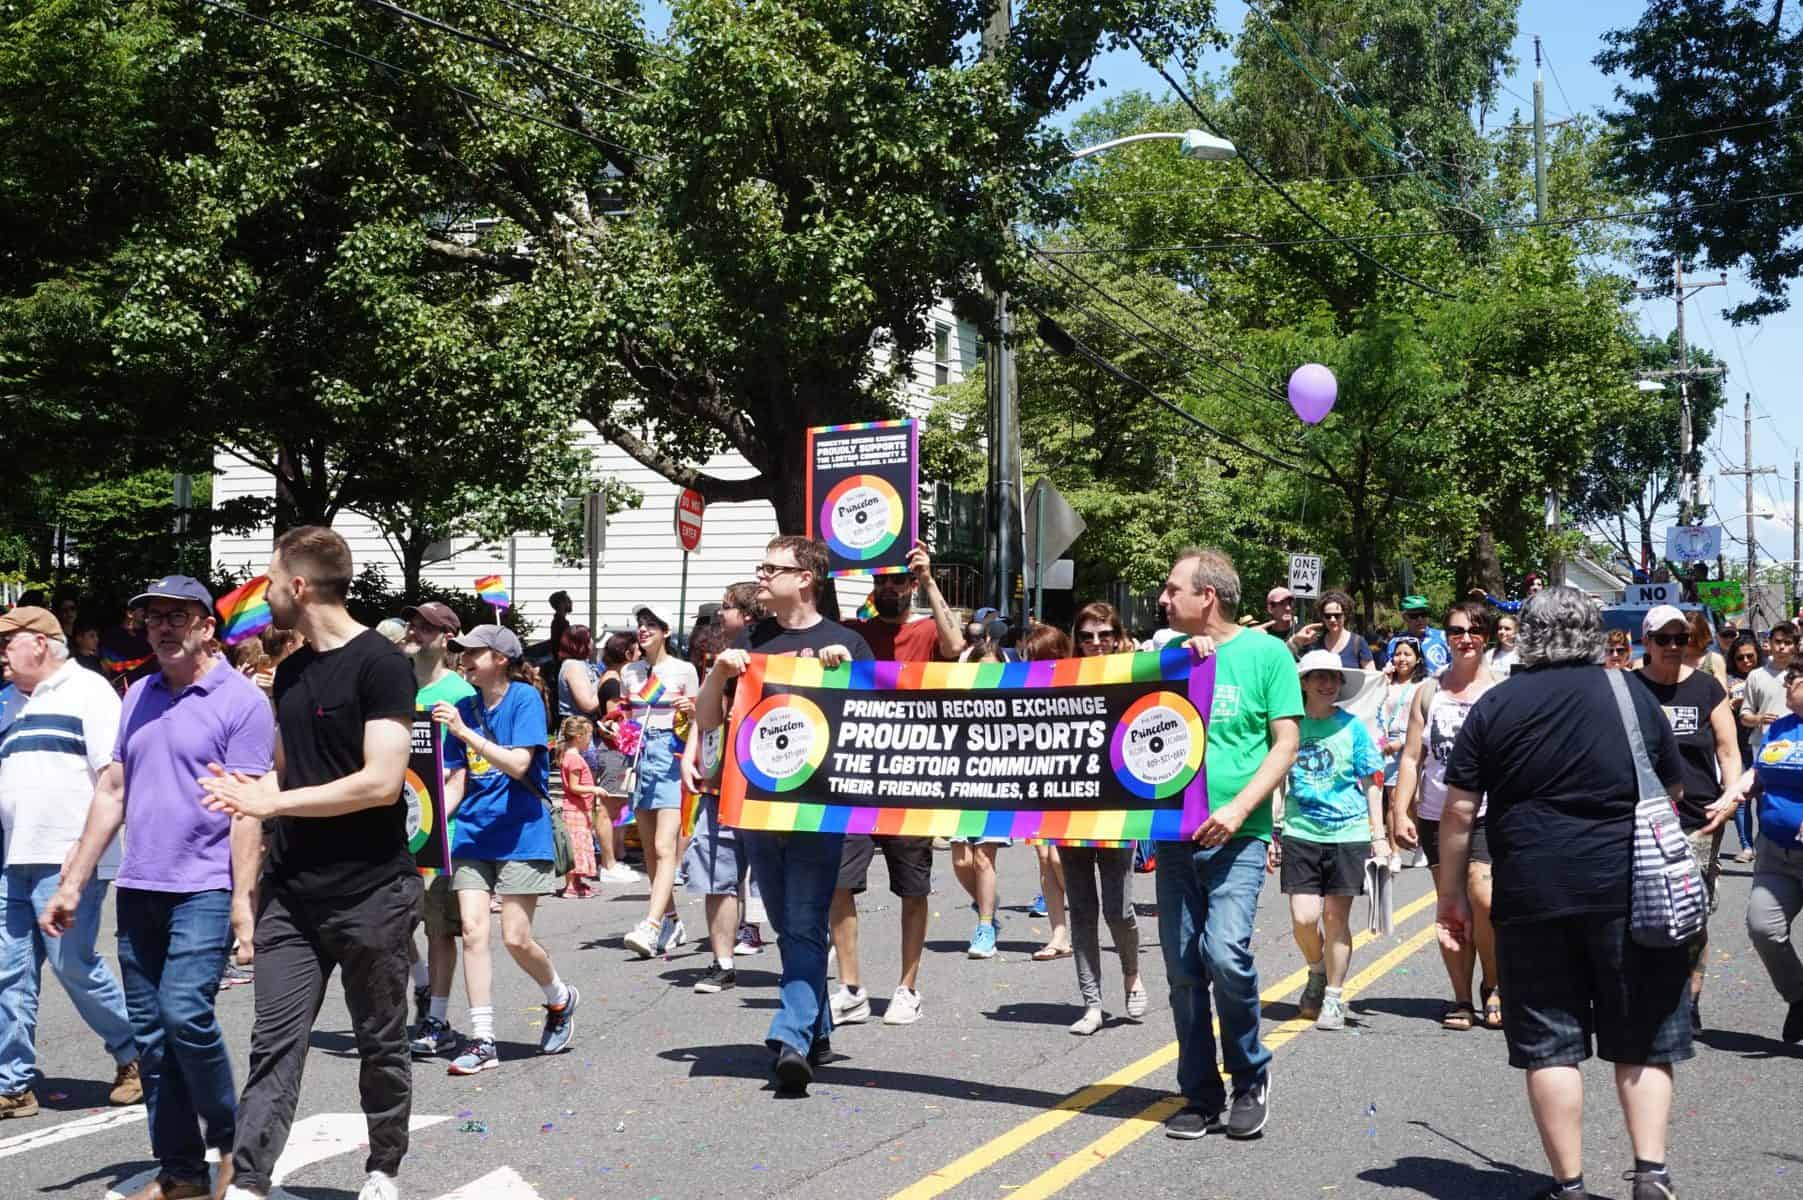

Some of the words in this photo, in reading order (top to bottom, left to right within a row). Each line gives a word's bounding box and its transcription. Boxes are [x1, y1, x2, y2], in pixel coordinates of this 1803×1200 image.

[682, 524, 697, 538] ENTER
[1294, 558, 1317, 569] ONE
[1293, 570, 1317, 580] WAY
[1640, 587, 1666, 600] NO
[843, 699, 938, 718] PRINCETON
[942, 699, 1006, 718] RECORD
[1012, 696, 1107, 717] EXCHANGE
[760, 721, 804, 739] Princeton
[837, 722, 959, 751] PROUDLY
[966, 720, 1106, 751] SUPPORTS
[1130, 719, 1178, 743] Princeton
[833, 752, 874, 774] THE
[877, 754, 960, 776] LGBTQIA
[965, 754, 1082, 777] COMMUNITY
[1086, 753, 1100, 774] &
[828, 777, 874, 795] THEIR
[877, 780, 945, 799] FRIENDS,
[949, 781, 1023, 800] FAMILIES,
[1027, 781, 1039, 798] &
[1043, 781, 1100, 798] ALLIES!
